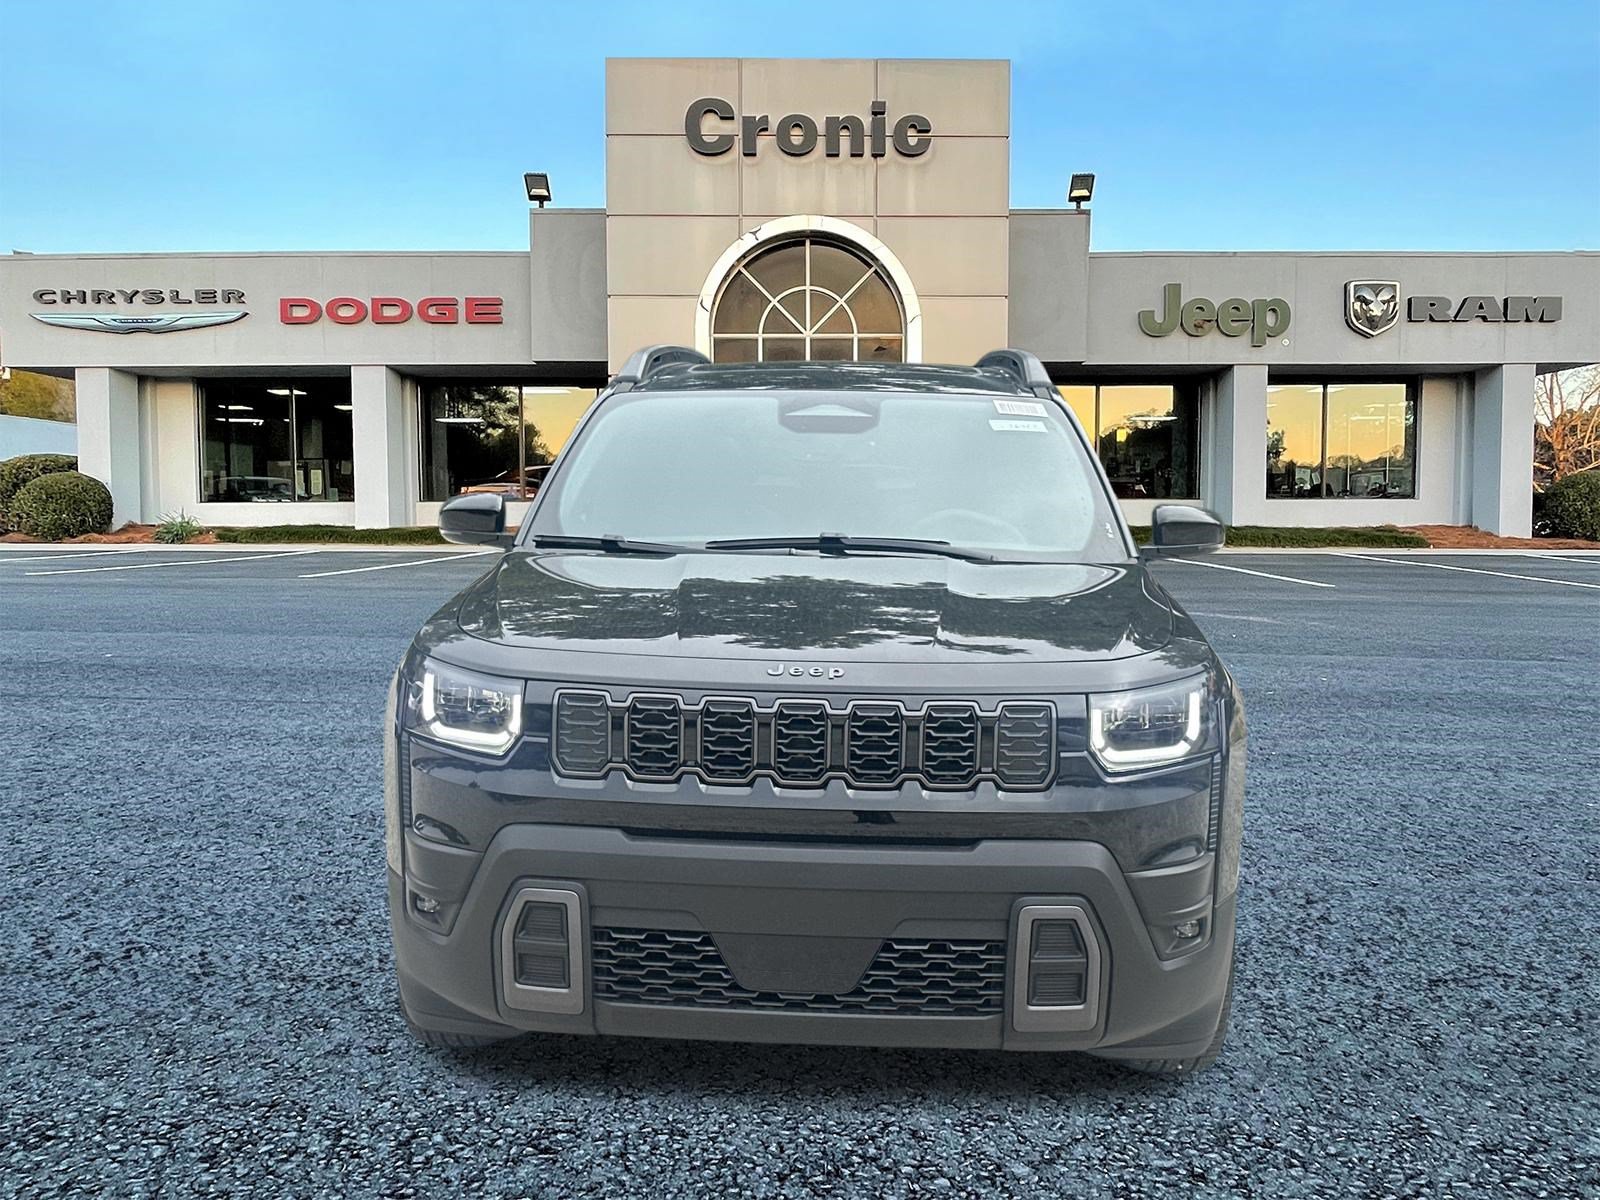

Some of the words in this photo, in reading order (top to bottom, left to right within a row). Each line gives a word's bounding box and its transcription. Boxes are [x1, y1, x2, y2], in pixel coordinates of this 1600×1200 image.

[685, 97, 932, 157] Cronic
[32, 288, 247, 304] CHRYSLER
[1408, 296, 1562, 322] RAM
[279, 297, 503, 324] DODGE
[1138, 283, 1291, 346] Jeep
[767, 664, 845, 680] Jeep
